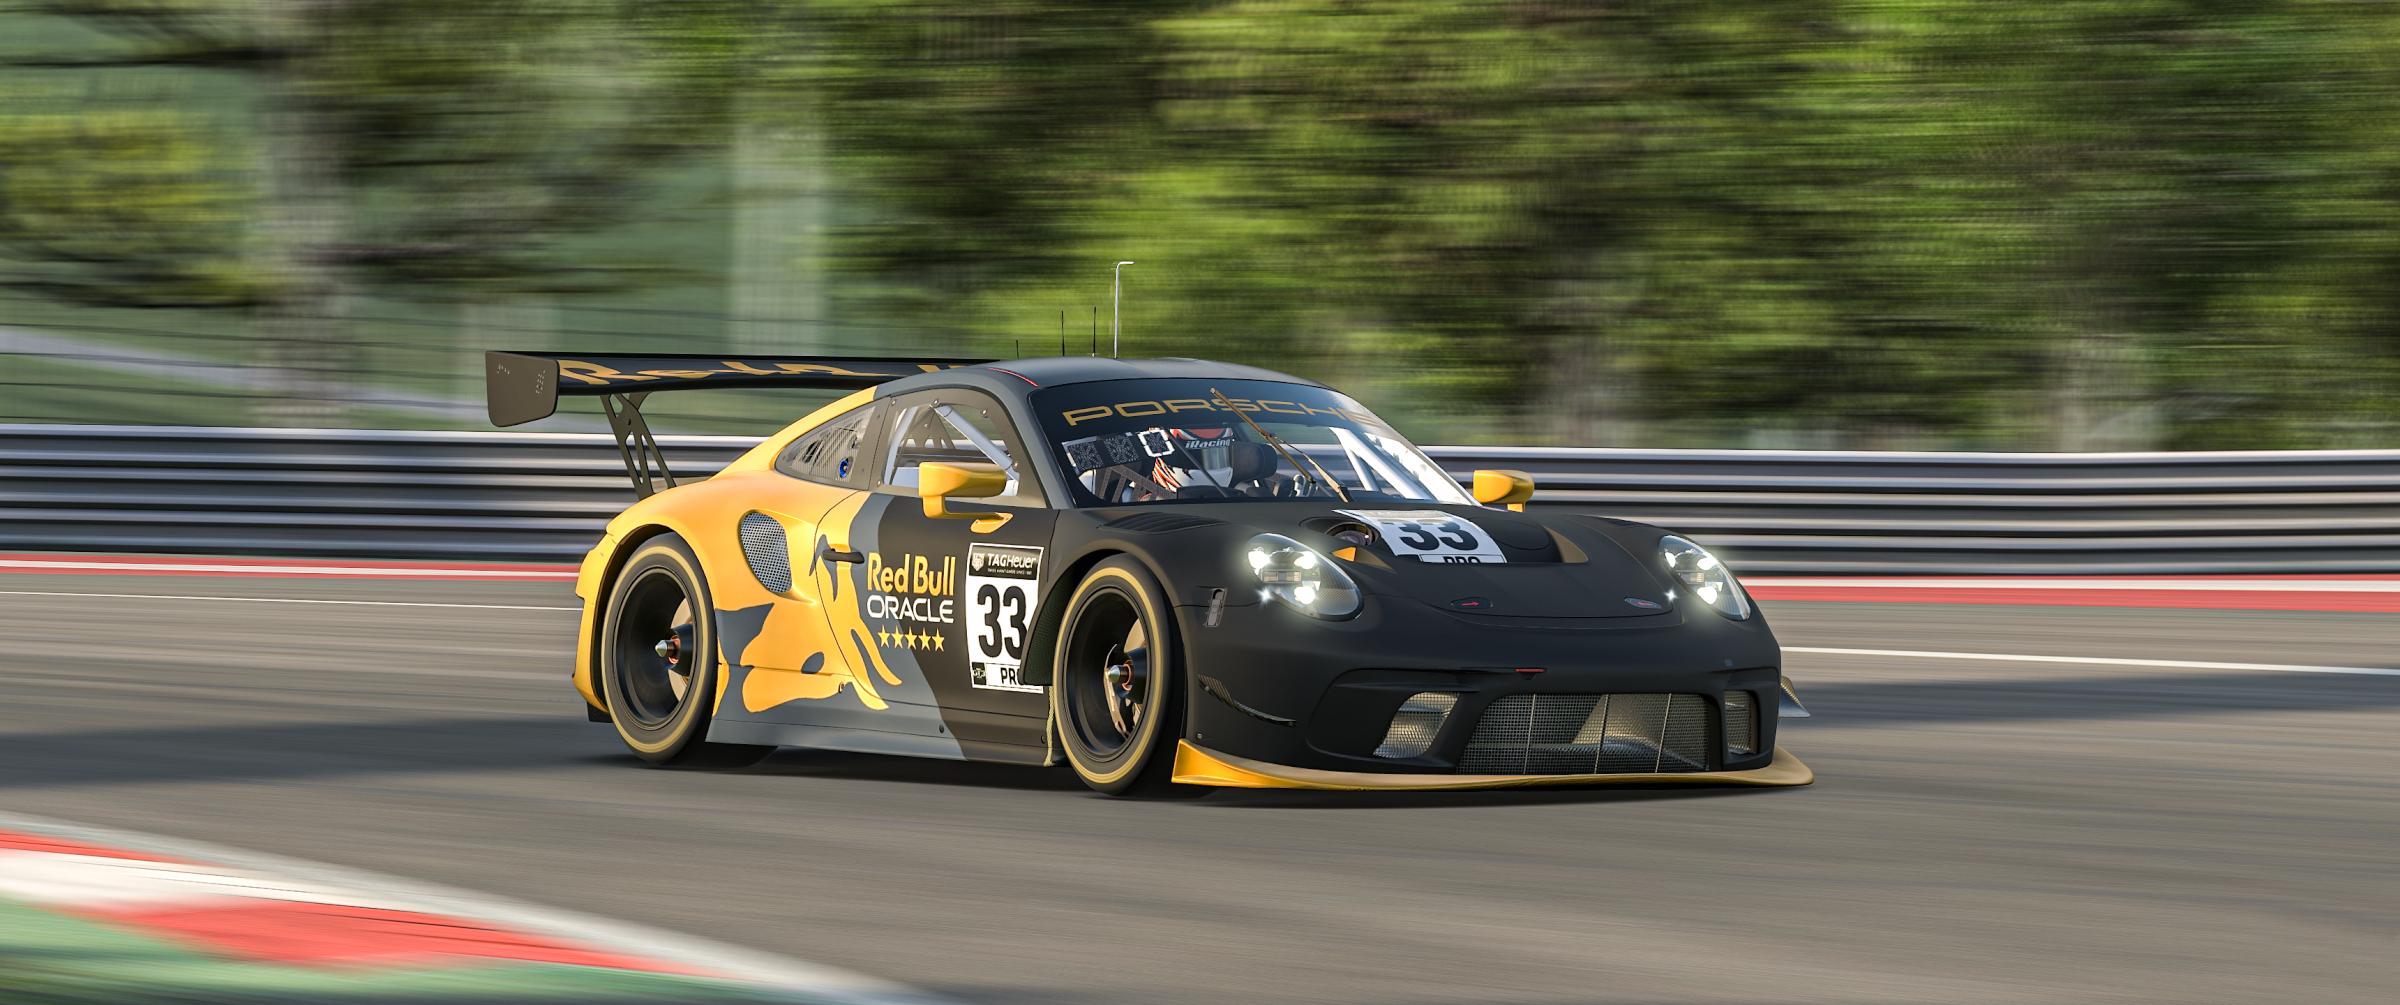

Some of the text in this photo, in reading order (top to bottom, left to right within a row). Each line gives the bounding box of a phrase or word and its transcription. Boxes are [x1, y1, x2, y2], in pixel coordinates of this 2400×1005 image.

[1062, 398, 1383, 429] PORSCHE
[1185, 438, 1231, 450] iRacing
[1378, 518, 1479, 551] 33
[867, 552, 910, 593] Red
[913, 555, 956, 597] Bull
[867, 594, 954, 624] ORACLE
[977, 583, 1028, 661] 33
[1000, 667, 1020, 686] PR
